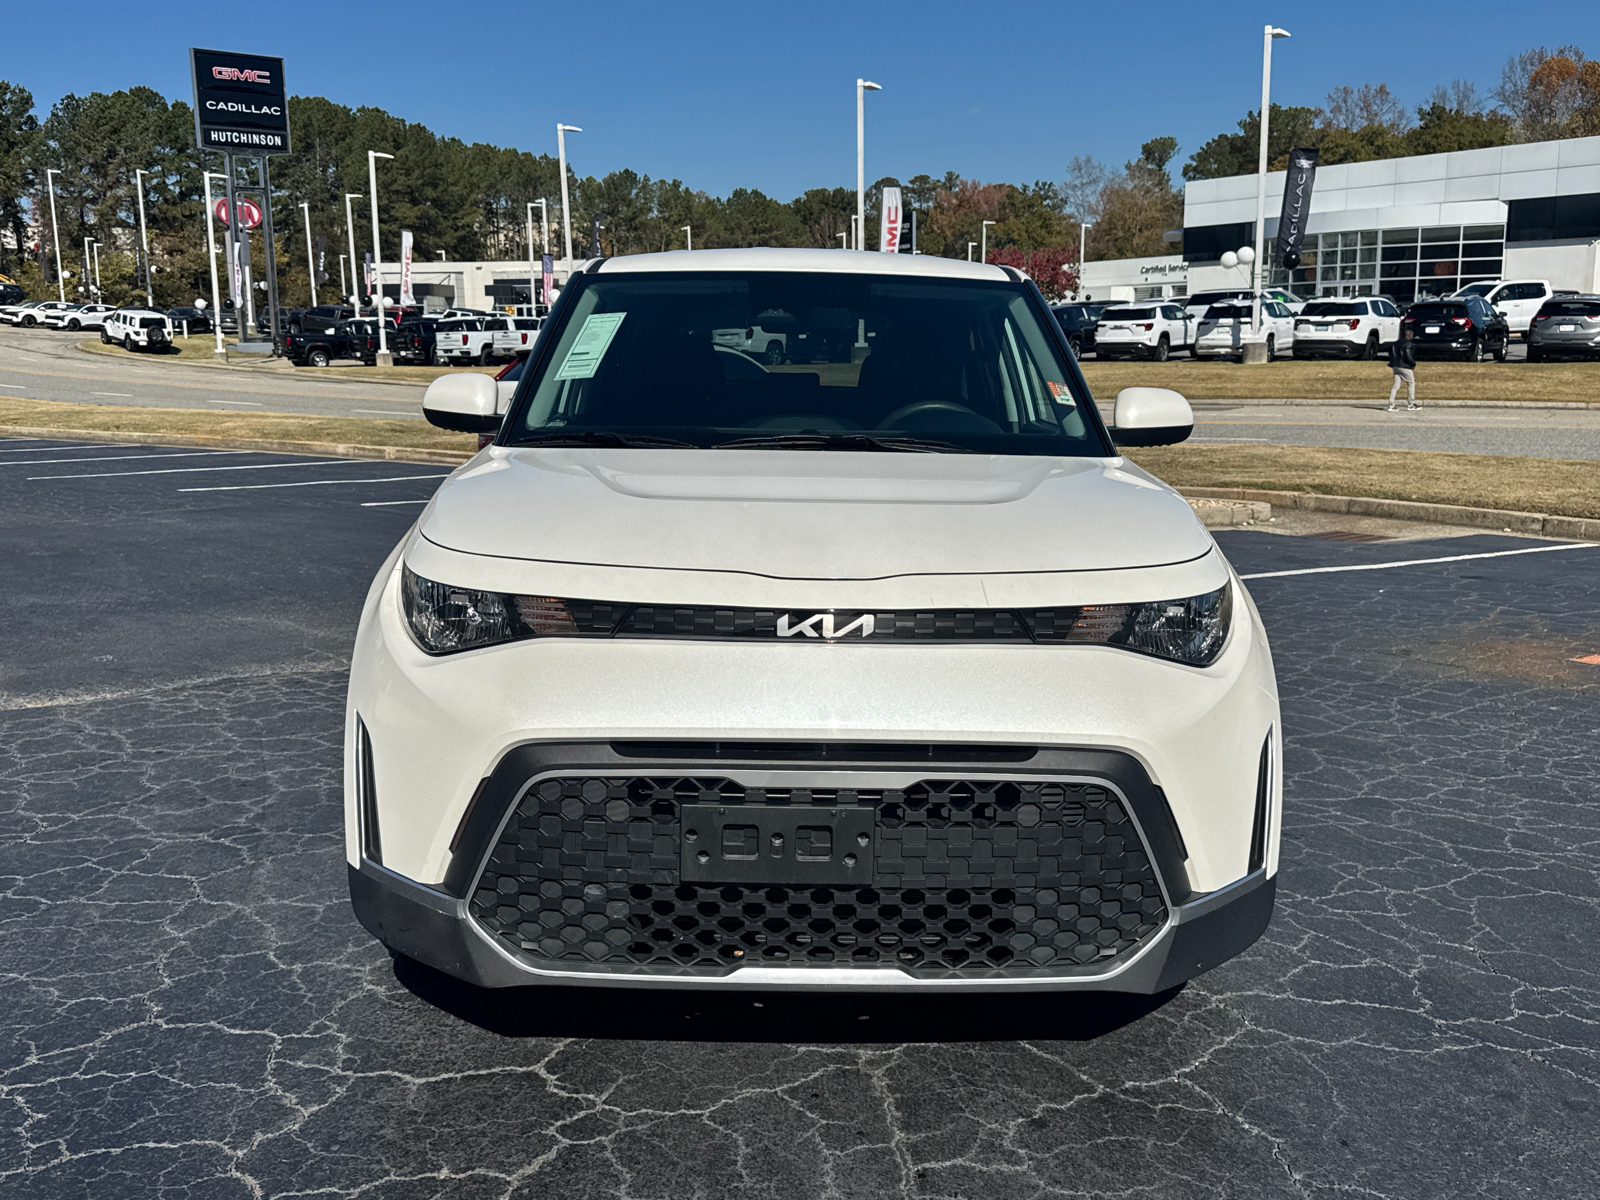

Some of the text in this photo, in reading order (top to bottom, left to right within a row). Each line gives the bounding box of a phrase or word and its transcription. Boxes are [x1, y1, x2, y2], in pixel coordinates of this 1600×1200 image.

[212, 66, 271, 84] GMC
[205, 100, 282, 116] CADILLAC
[210, 130, 282, 147] HUTCHINSON
[885, 206, 899, 254] MC
[403, 246, 412, 294] GMC
[1140, 264, 1167, 275] Certified
[1168, 262, 1189, 273] Servic
[776, 613, 875, 638] KIA
